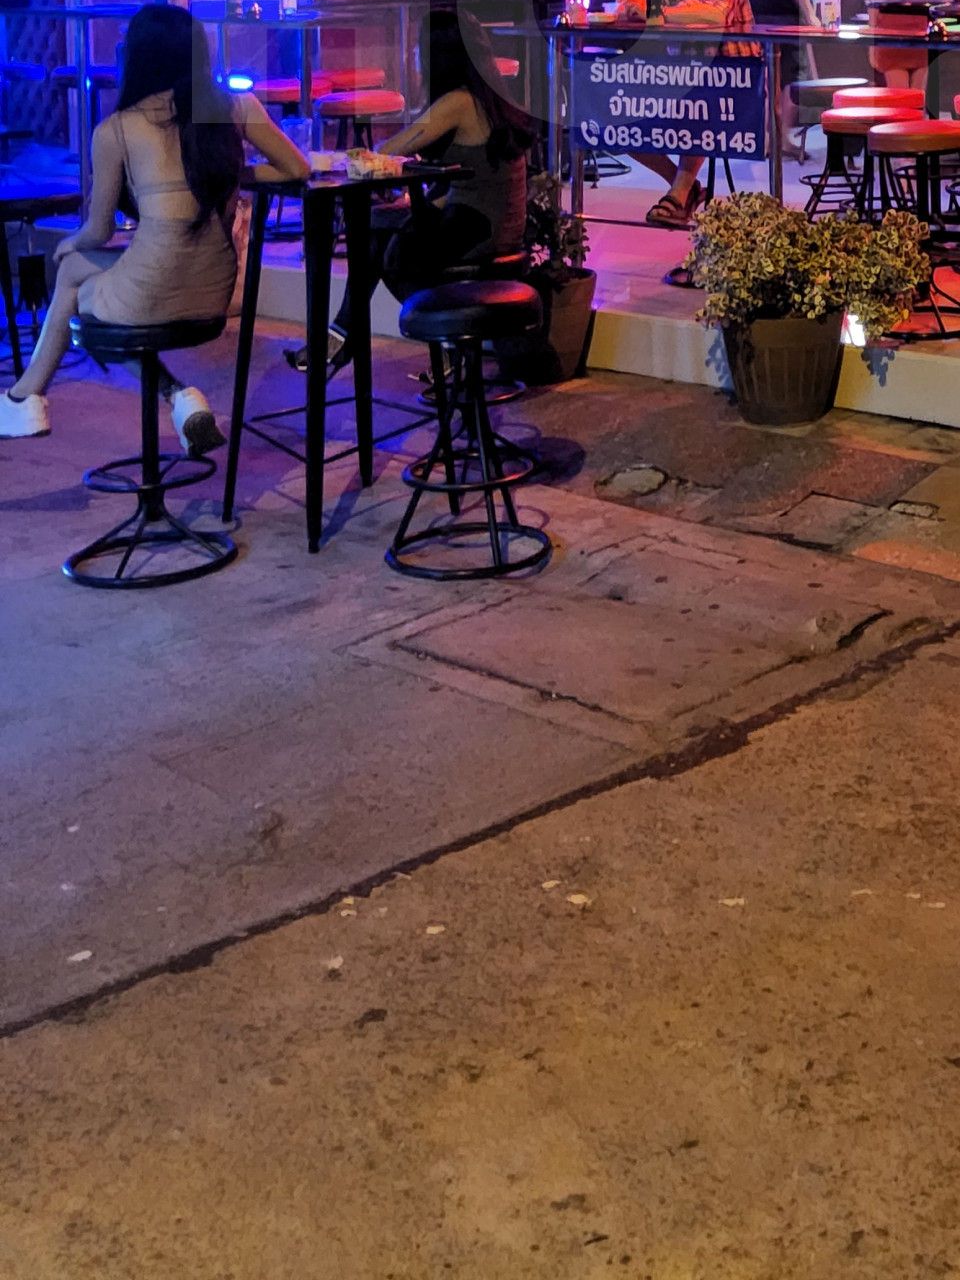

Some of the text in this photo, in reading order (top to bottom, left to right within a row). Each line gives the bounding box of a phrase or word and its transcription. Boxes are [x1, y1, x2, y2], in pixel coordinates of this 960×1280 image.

[590, 56, 751, 88] รับสมัครพนักงาน
[609, 89, 709, 120] จำนวนมาก
[603, 124, 756, 153] 083-503-8145
